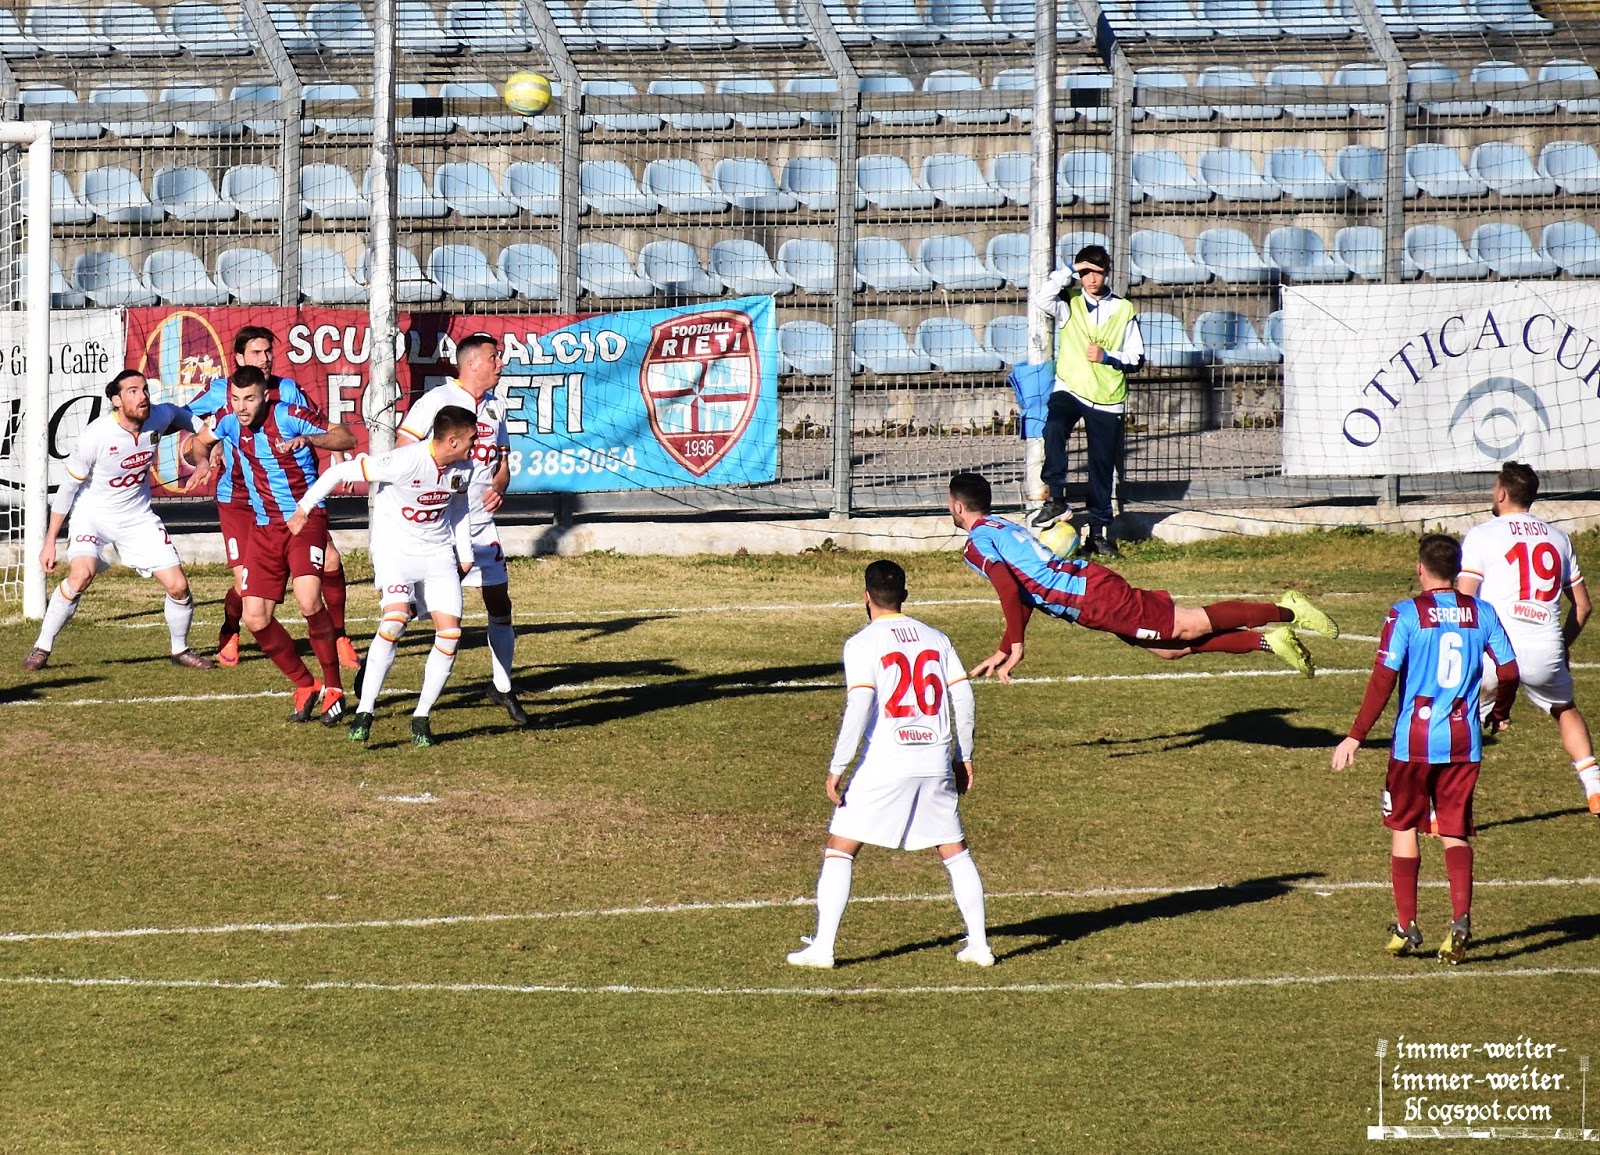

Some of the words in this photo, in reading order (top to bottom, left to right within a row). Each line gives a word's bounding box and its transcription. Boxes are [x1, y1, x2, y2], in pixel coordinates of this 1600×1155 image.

[671, 321, 733, 338] FOOTBALL
[287, 324, 458, 364] SCULA
[472, 329, 628, 367] ALCIO
[661, 332, 742, 357] RIETI
[61, 341, 109, 375] Caffè
[1343, 309, 1508, 448] OTTICA
[527, 445, 637, 476] 3853054
[684, 439, 715, 458] 1936
[1508, 521, 1522, 536] DE
[1524, 521, 1549, 536] RISIO
[1504, 542, 1562, 603] 19
[1428, 606, 1473, 623] SERENA
[1513, 603, 1548, 621] Wüber
[891, 627, 920, 643] TULLI
[1437, 631, 1464, 690] 6
[880, 649, 944, 719] 26
[898, 728, 934, 742] Wüber
